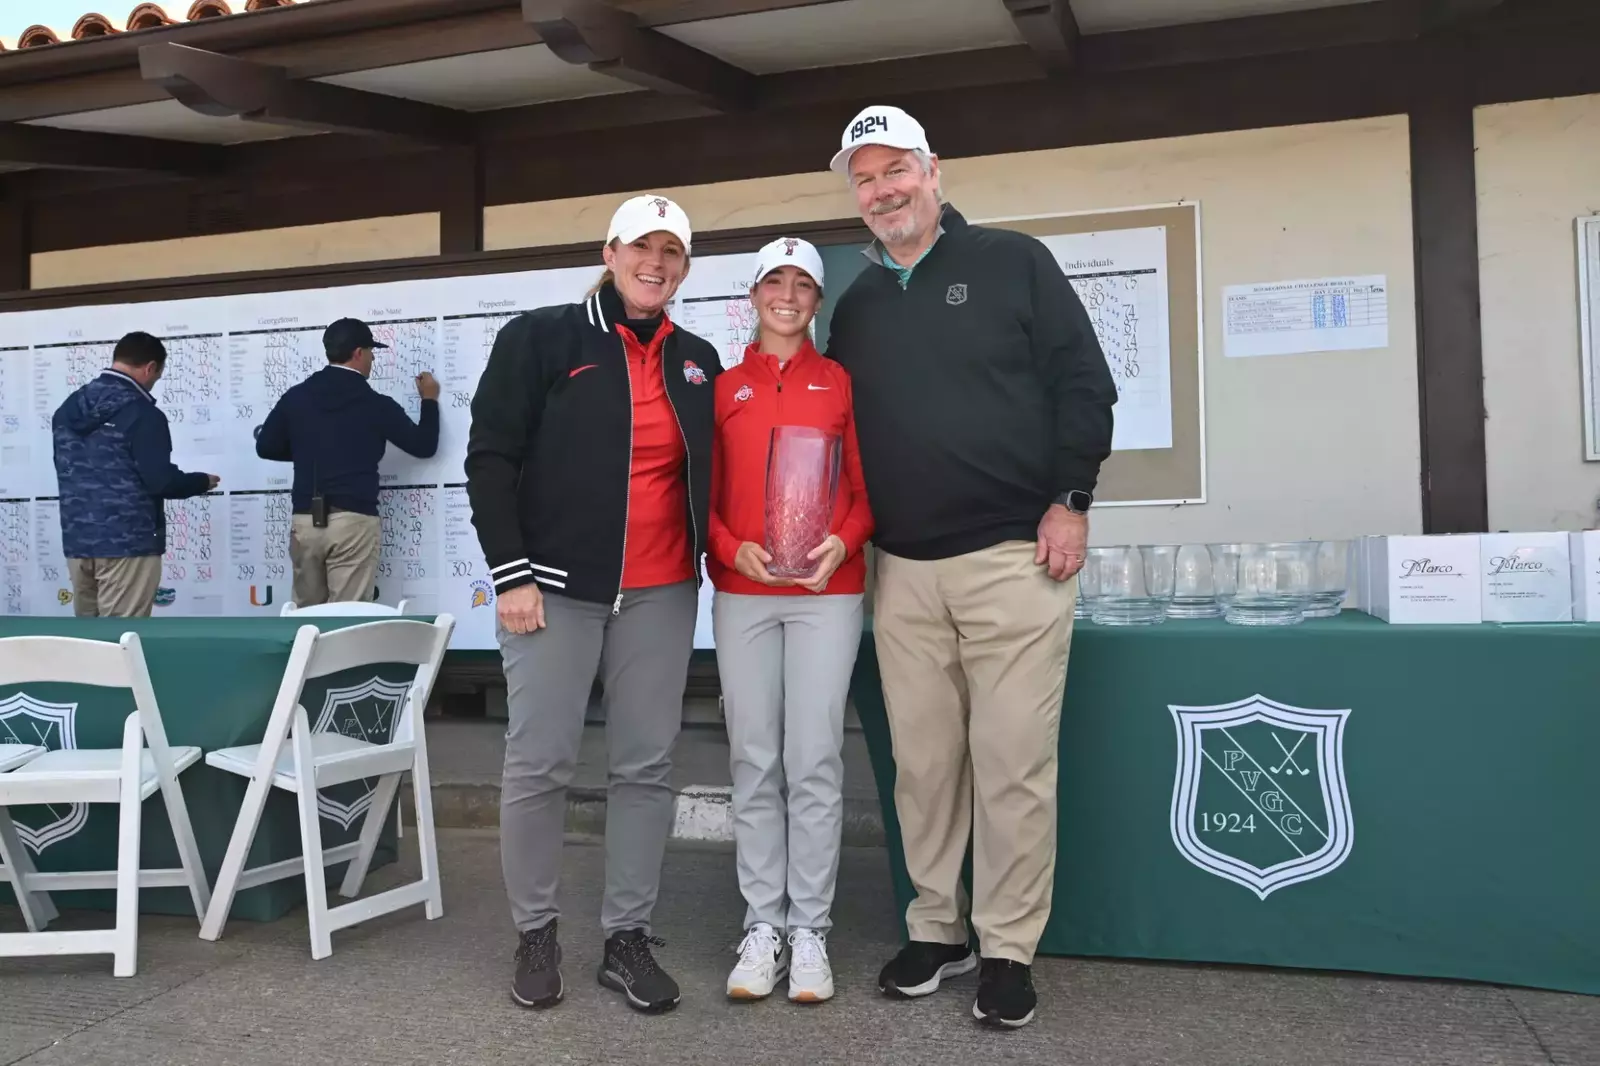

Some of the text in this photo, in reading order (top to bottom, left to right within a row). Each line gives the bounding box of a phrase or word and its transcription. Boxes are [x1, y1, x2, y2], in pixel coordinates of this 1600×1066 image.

[850, 116, 888, 142] 1924
[1065, 259, 1114, 269] Individuals
[1124, 362, 1140, 378] 80
[452, 392, 471, 408] 288
[237, 564, 285, 580] 299 299
[452, 561, 473, 577] 302
[1399, 557, 1453, 579] Marco
[1487, 555, 1543, 576] Marco
[1201, 812, 1257, 833] 1924
